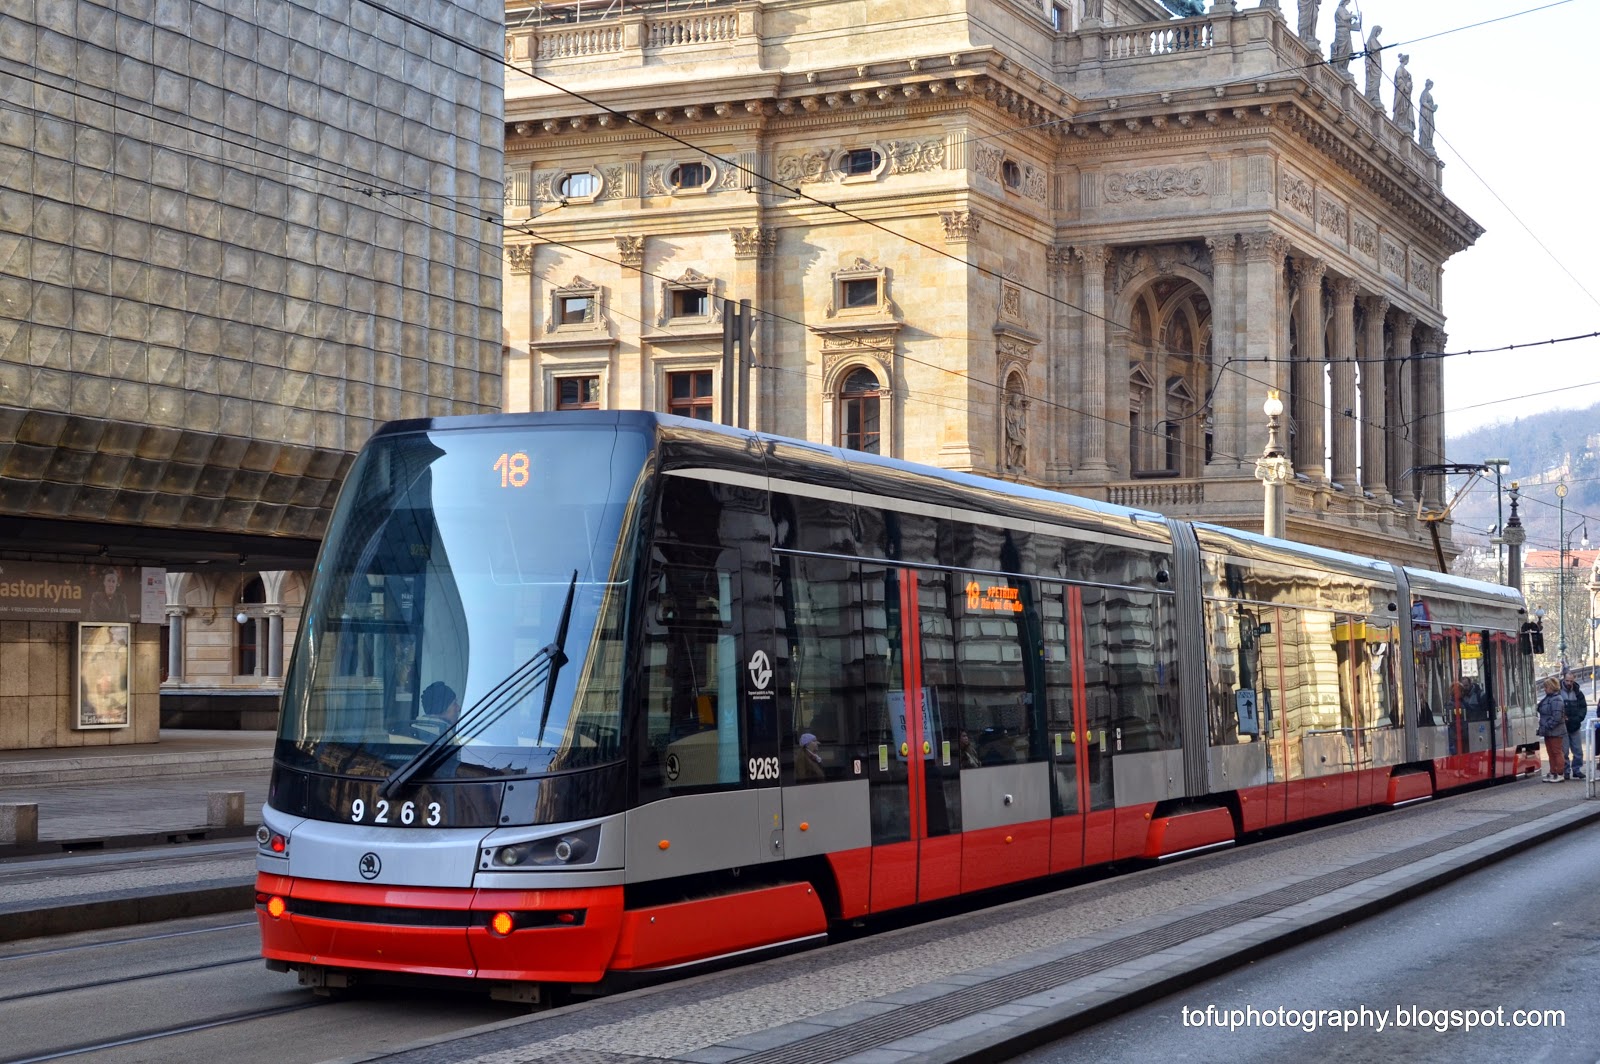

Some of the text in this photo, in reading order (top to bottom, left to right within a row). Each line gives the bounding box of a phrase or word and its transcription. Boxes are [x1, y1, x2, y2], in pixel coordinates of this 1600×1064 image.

[493, 452, 530, 488] 18
[966, 581, 980, 609] 18
[748, 756, 780, 781] 9263
[351, 798, 441, 826] 9263
